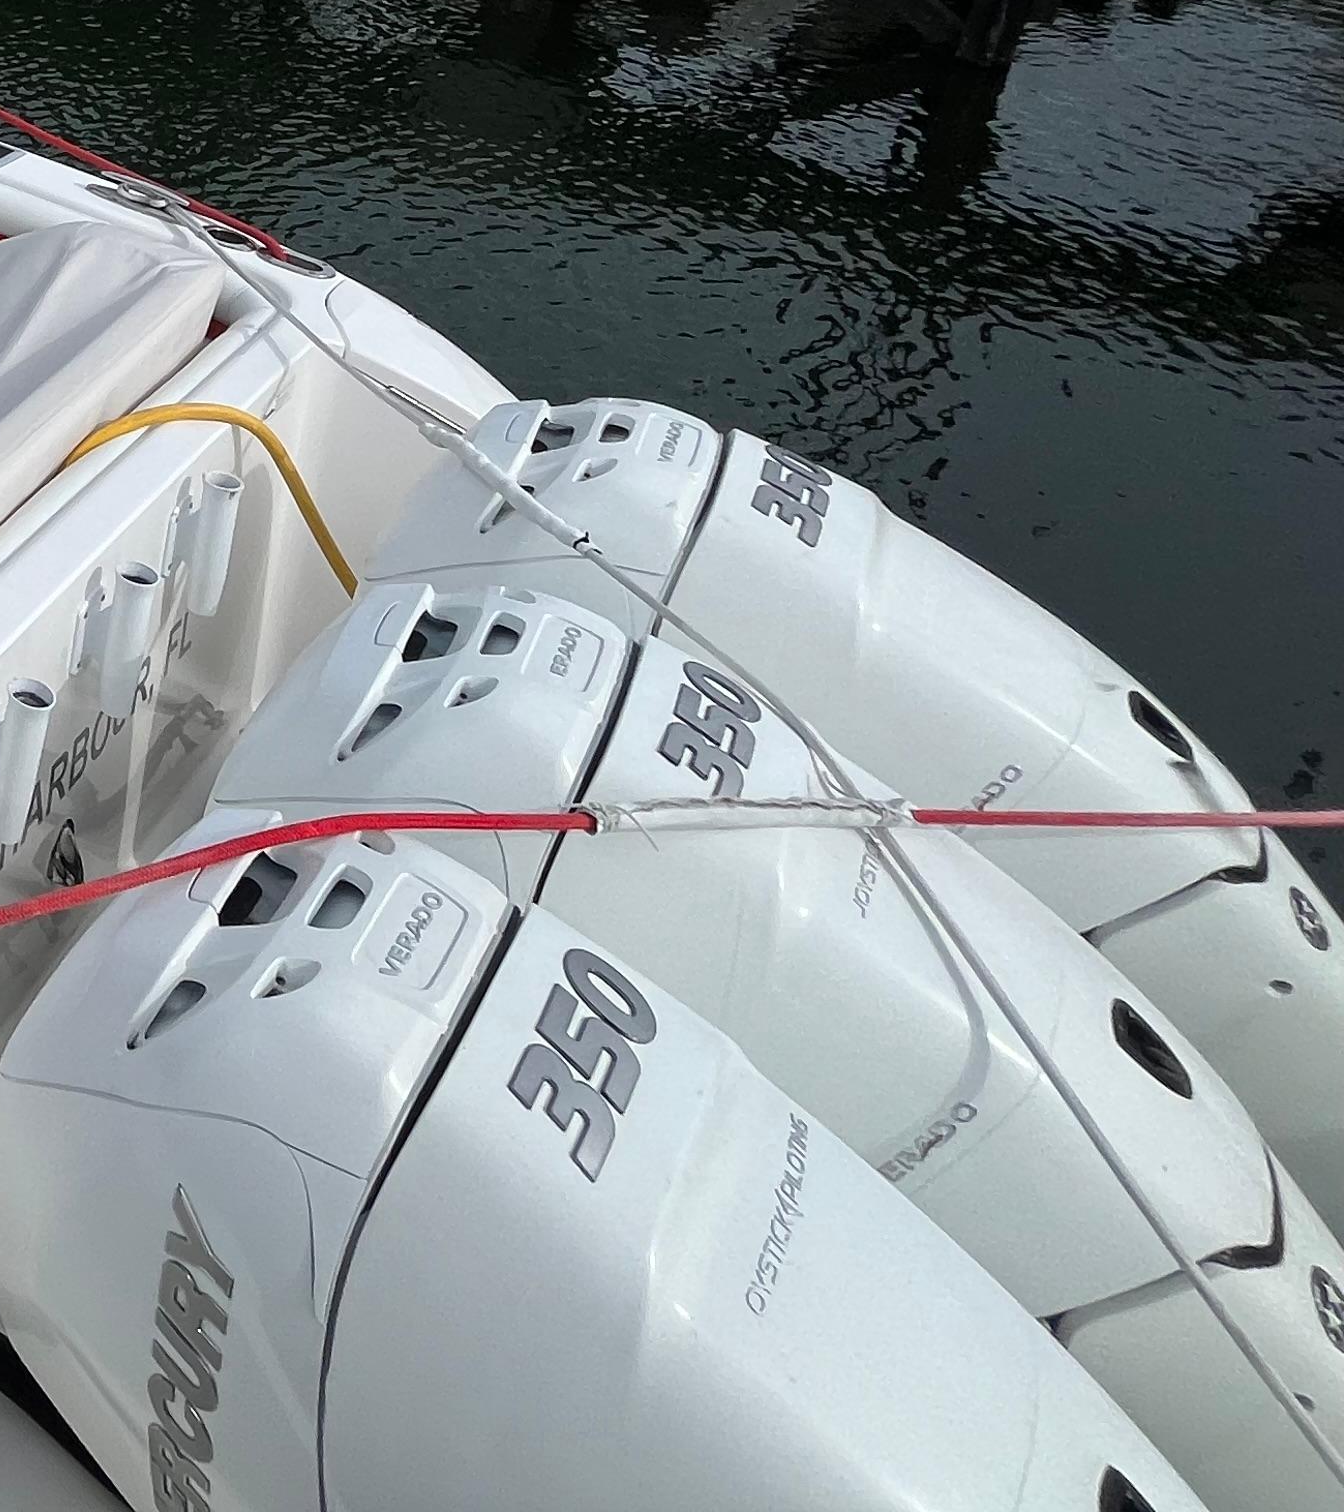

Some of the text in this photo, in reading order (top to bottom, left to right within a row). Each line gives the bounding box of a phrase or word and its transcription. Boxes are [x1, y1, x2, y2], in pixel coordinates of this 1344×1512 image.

[750, 444, 833, 548] 350
[164, 612, 192, 678] FL
[656, 660, 762, 798] 350
[378, 891, 444, 977] VERADO
[507, 947, 657, 1184] 350
